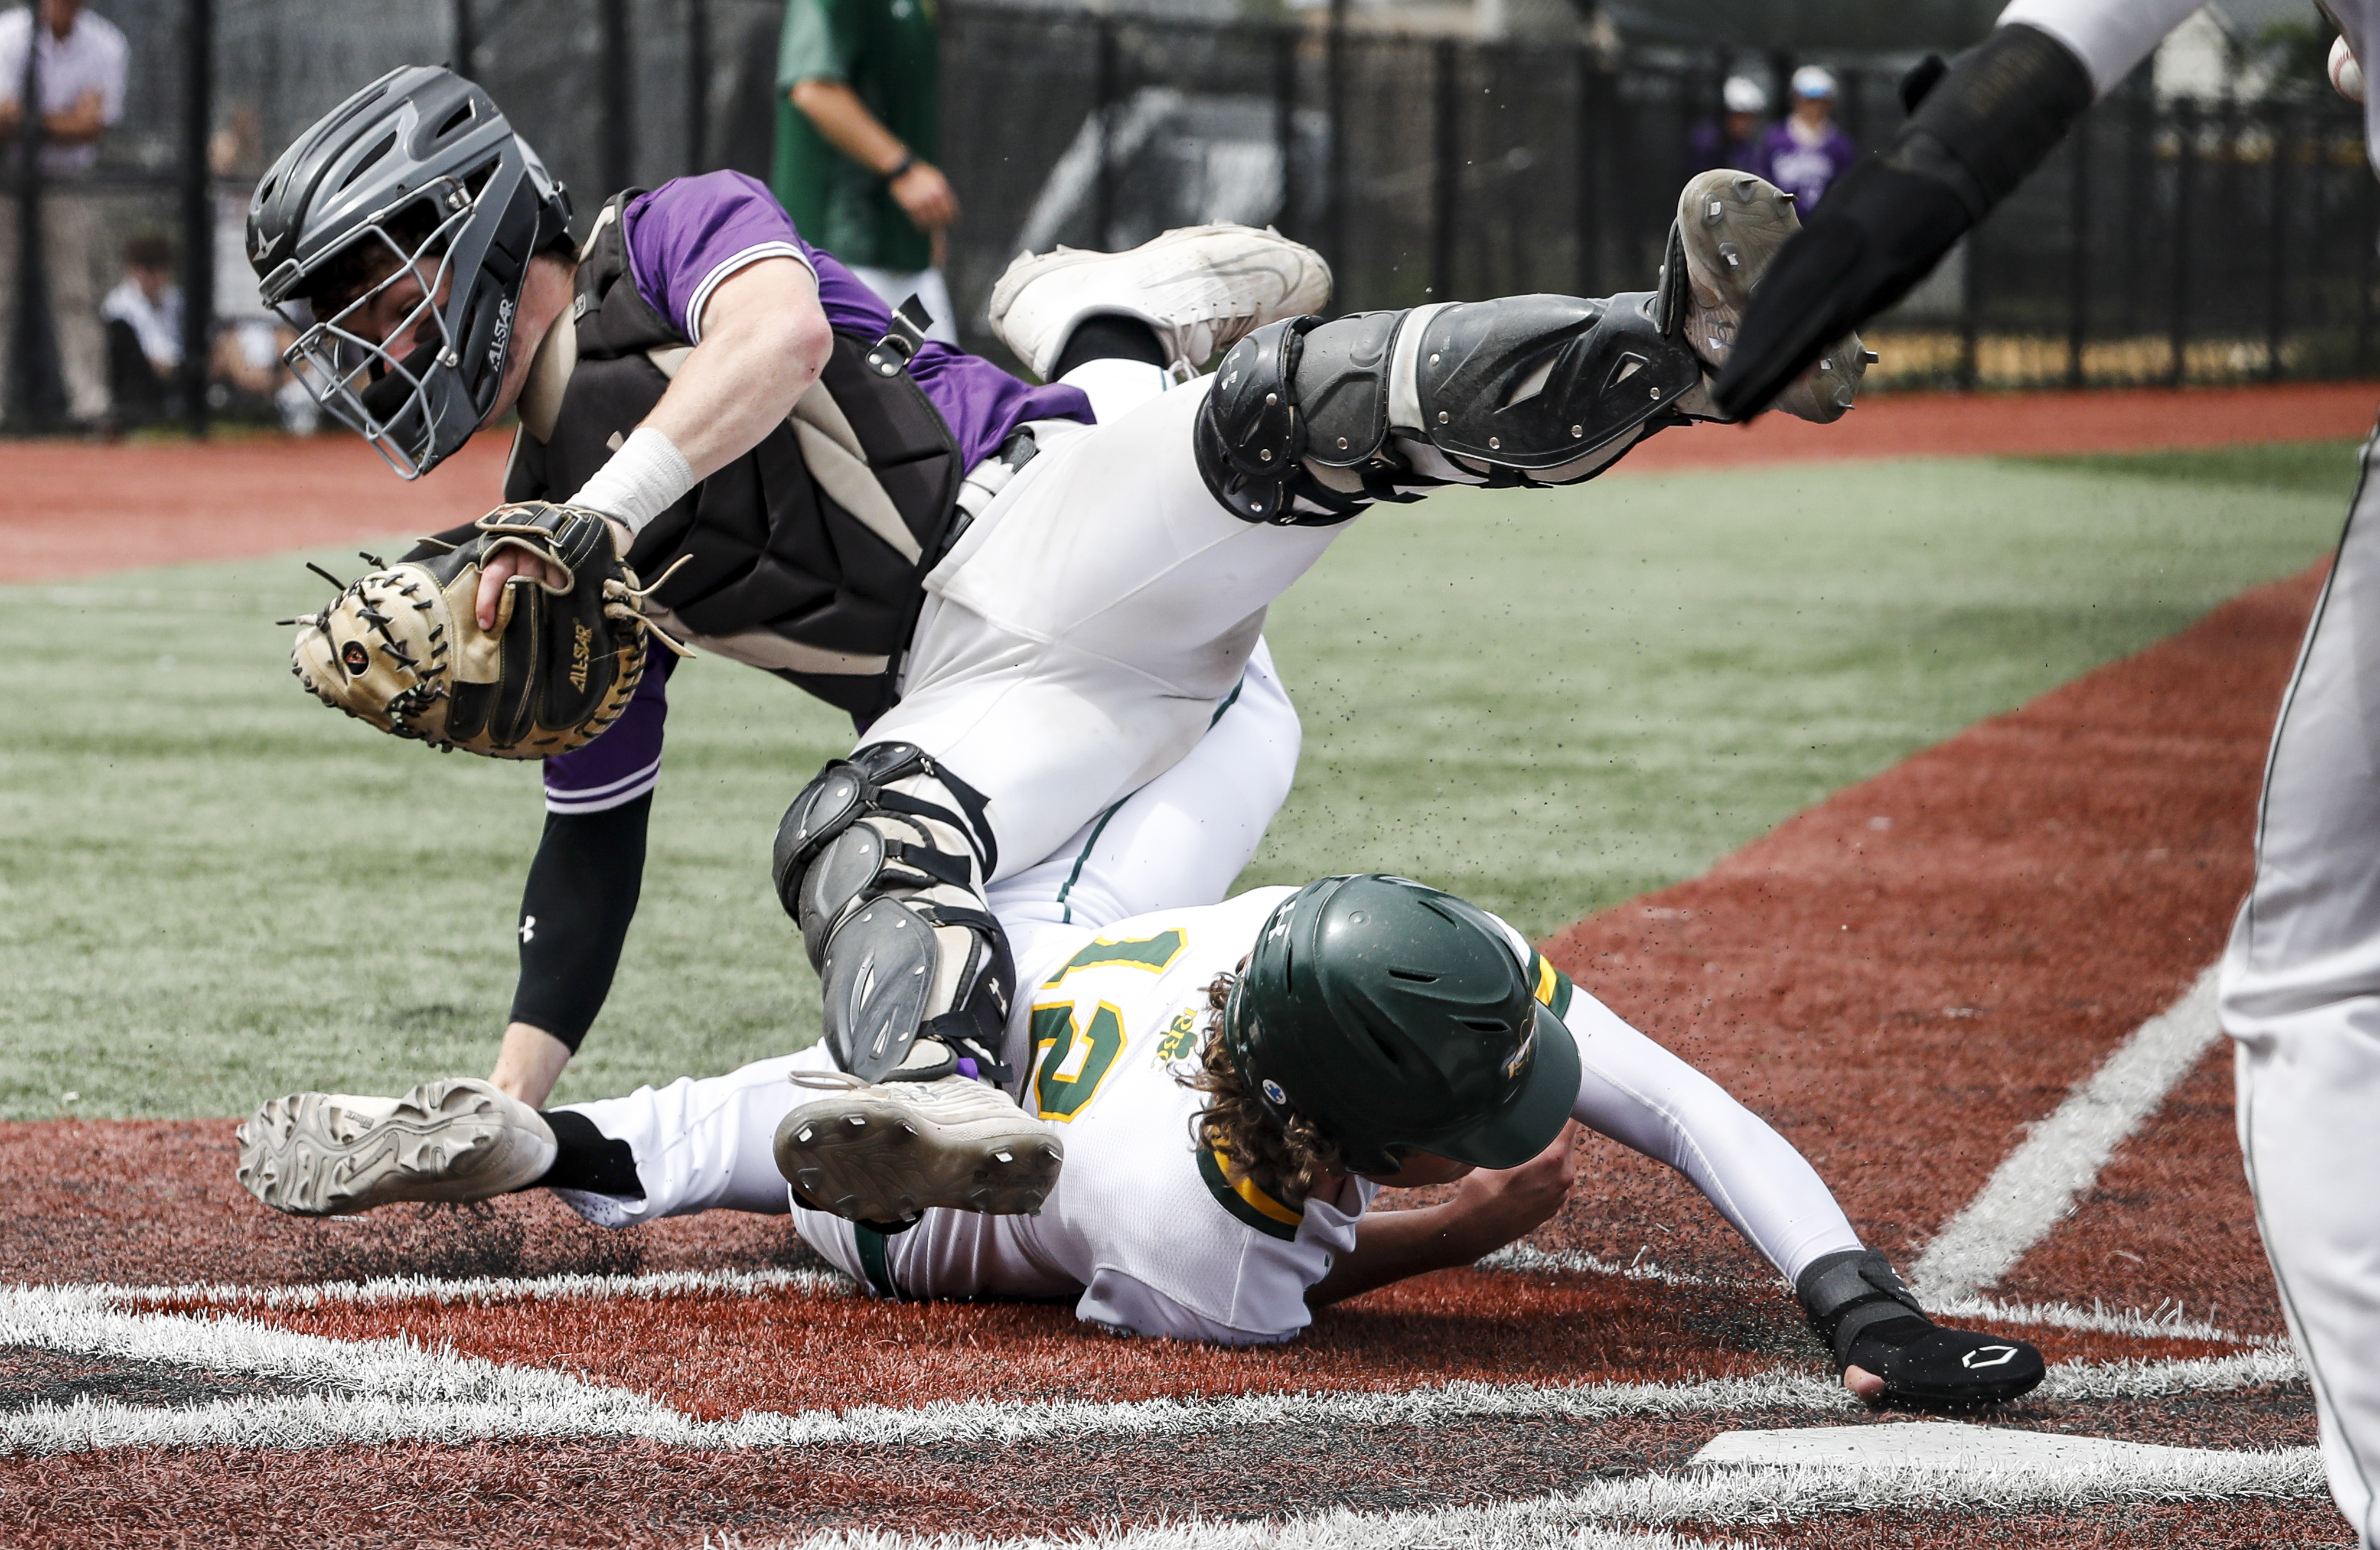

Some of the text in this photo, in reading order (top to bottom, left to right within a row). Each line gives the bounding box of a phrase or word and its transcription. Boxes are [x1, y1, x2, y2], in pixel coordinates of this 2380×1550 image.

[488, 298, 513, 372] ALL-STAR
[569, 624, 592, 694] ALL-STAR
[1019, 927, 1189, 1124] 12
[1150, 1007, 1198, 1072] RBC
